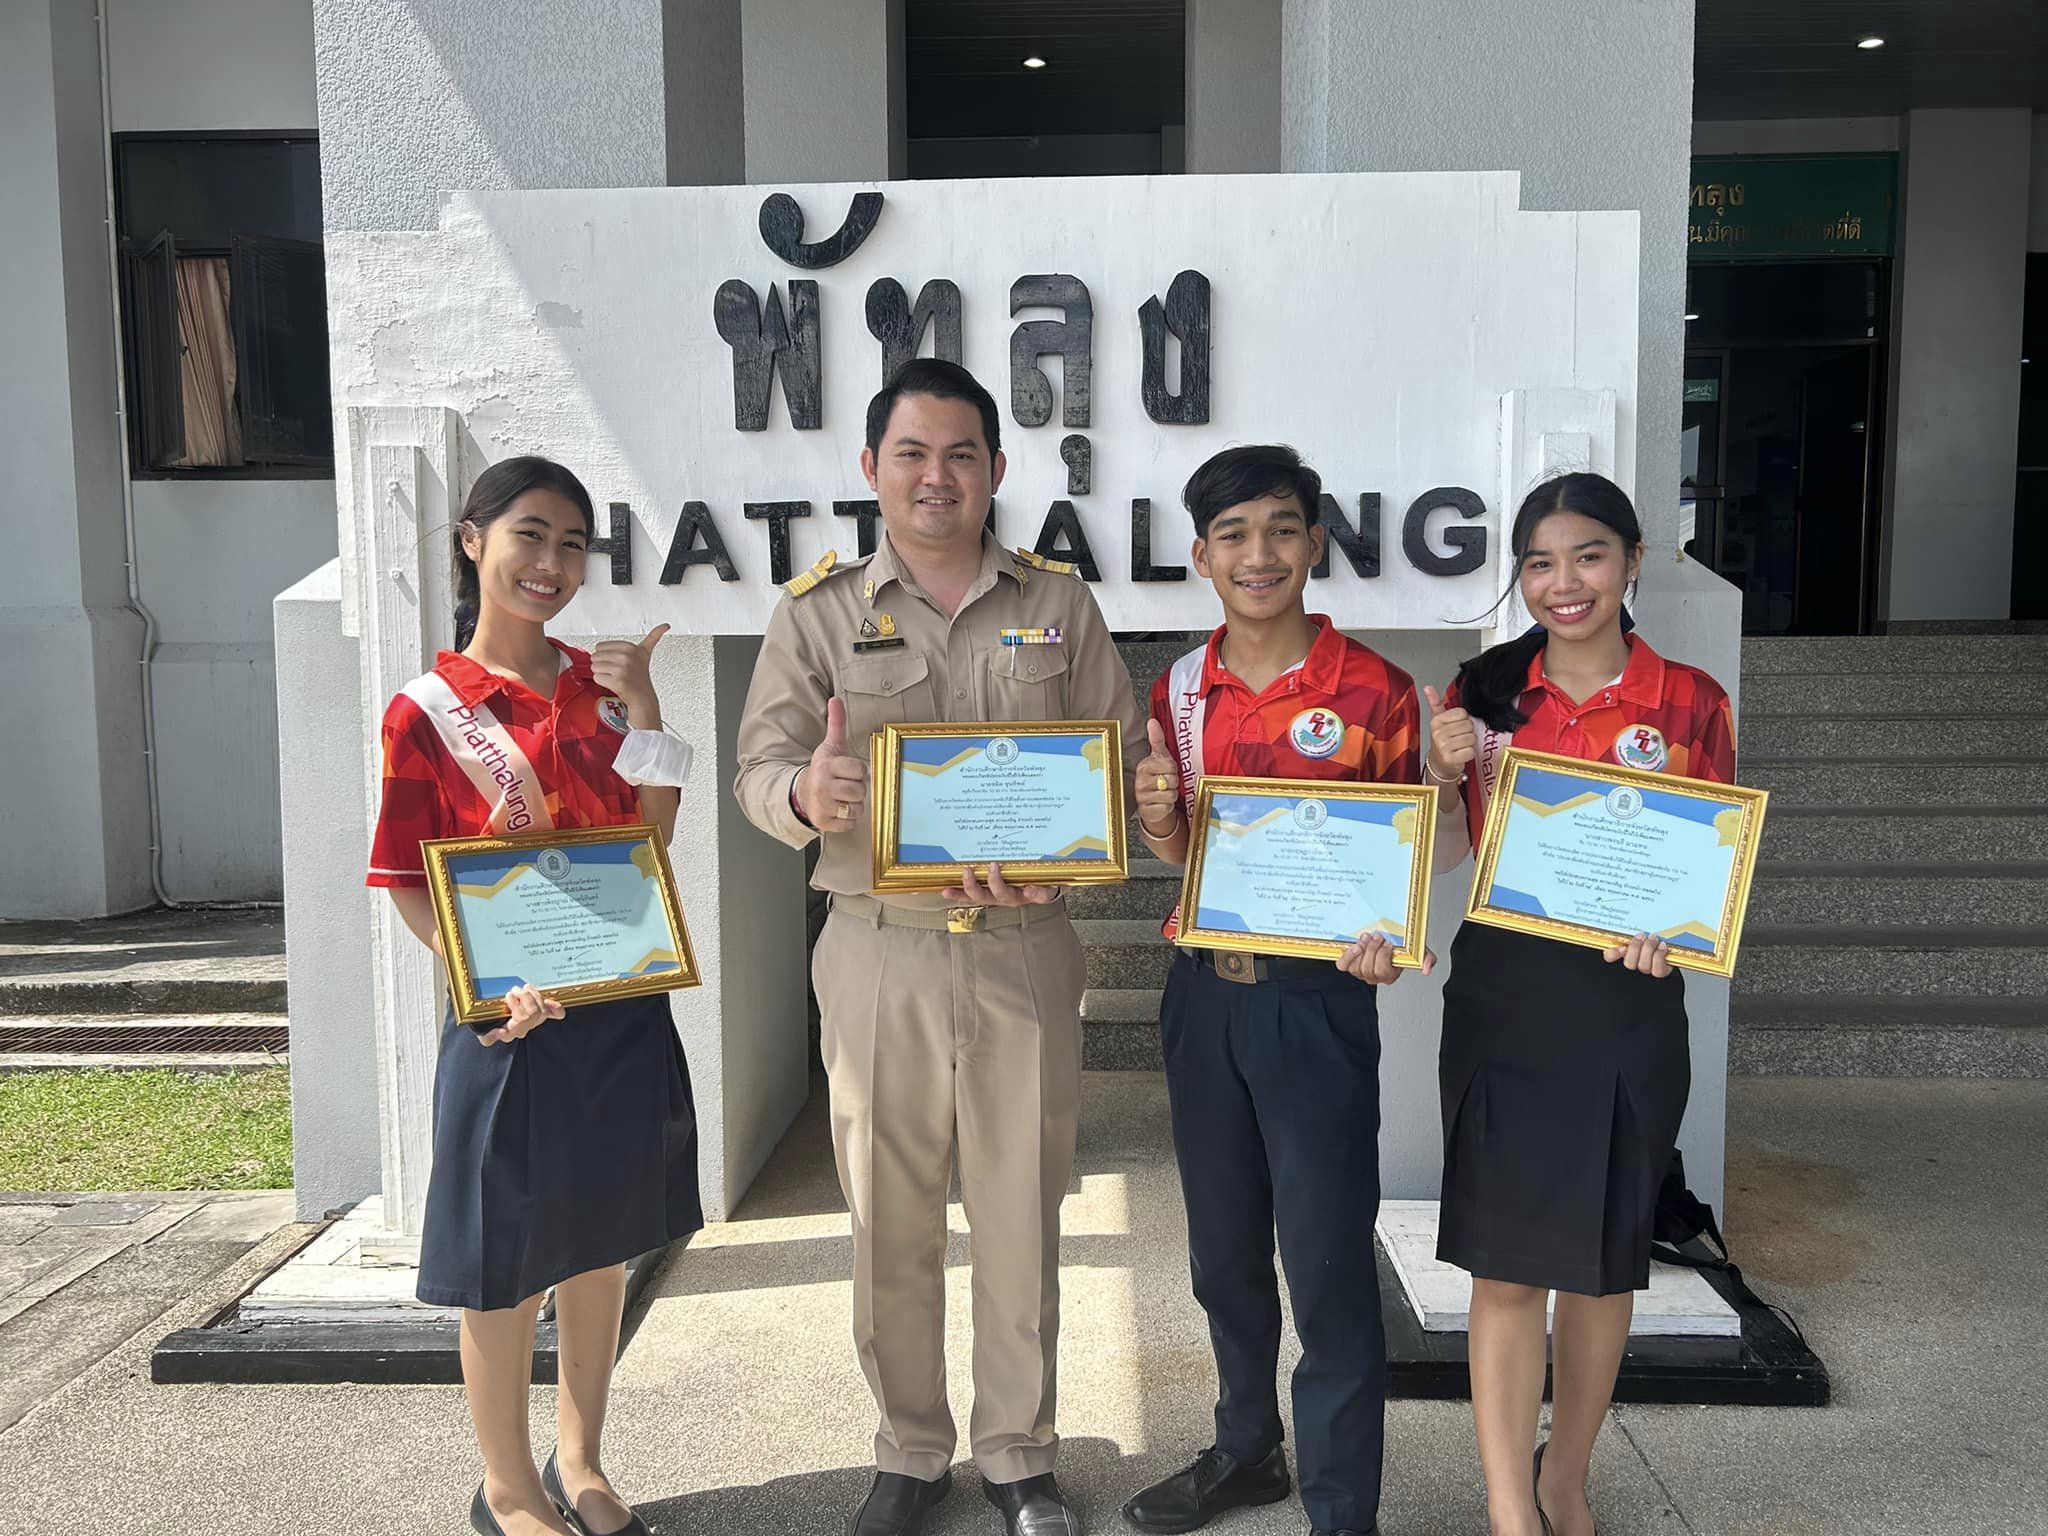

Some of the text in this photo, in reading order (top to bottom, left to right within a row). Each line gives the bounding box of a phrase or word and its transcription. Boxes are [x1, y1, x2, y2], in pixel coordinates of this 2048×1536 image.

[713, 191, 1211, 496] พัทลุง
[582, 486, 1488, 586] HATTALNG
[447, 705, 532, 832] Phatthalung
